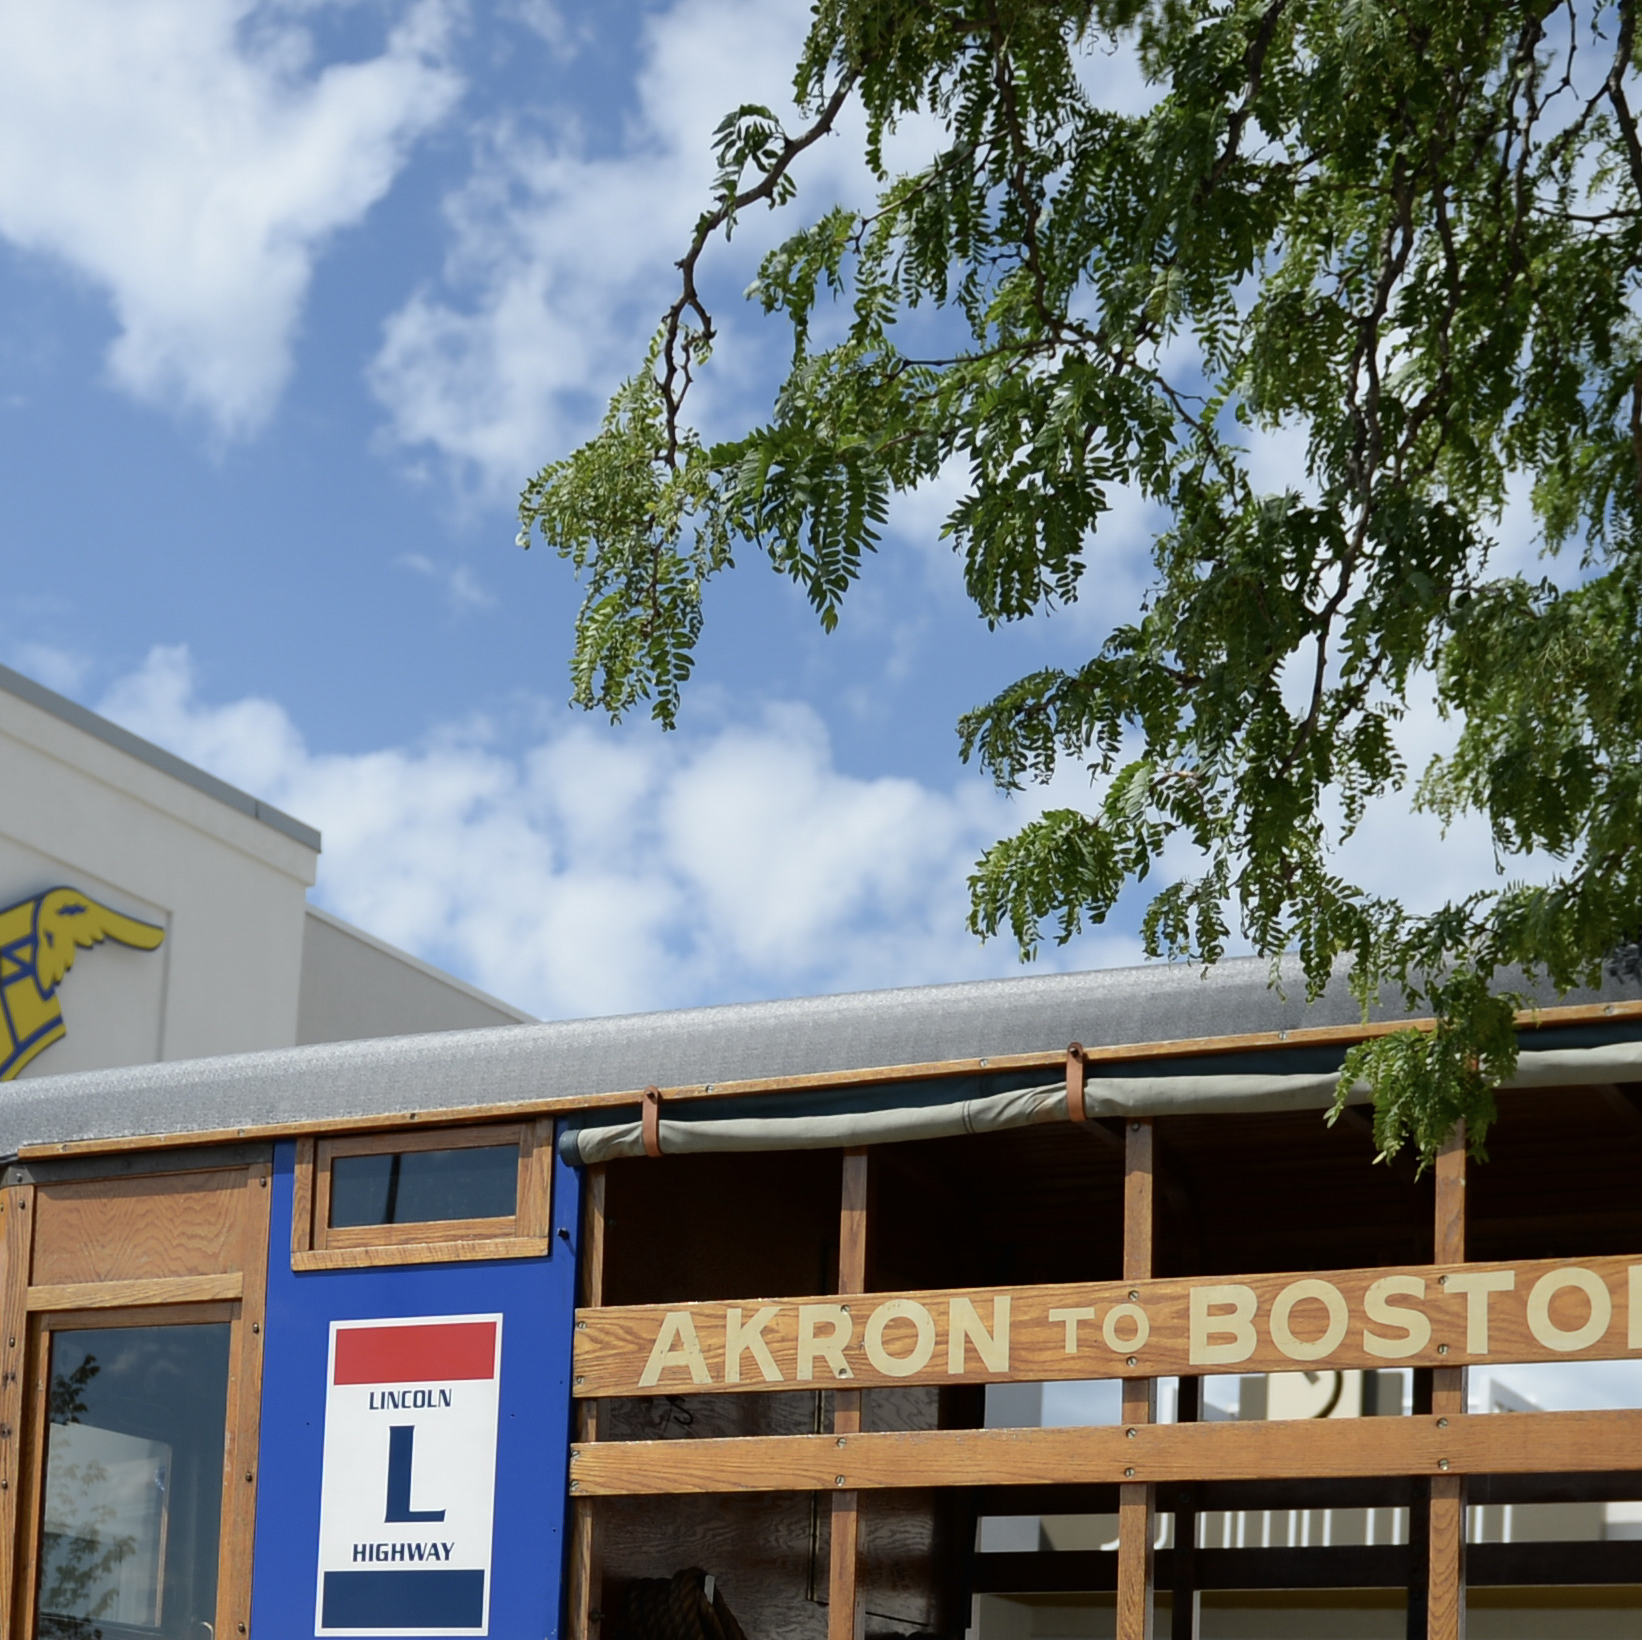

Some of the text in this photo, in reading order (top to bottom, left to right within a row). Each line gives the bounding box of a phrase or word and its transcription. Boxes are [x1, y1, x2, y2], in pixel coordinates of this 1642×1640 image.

[638, 1294, 1012, 1388] AKRON
[1047, 1302, 1150, 1355] TO
[368, 1388, 453, 1411] LINCOLN
[384, 1424, 447, 1524] L
[352, 1541, 455, 1564] HIGHWAY
